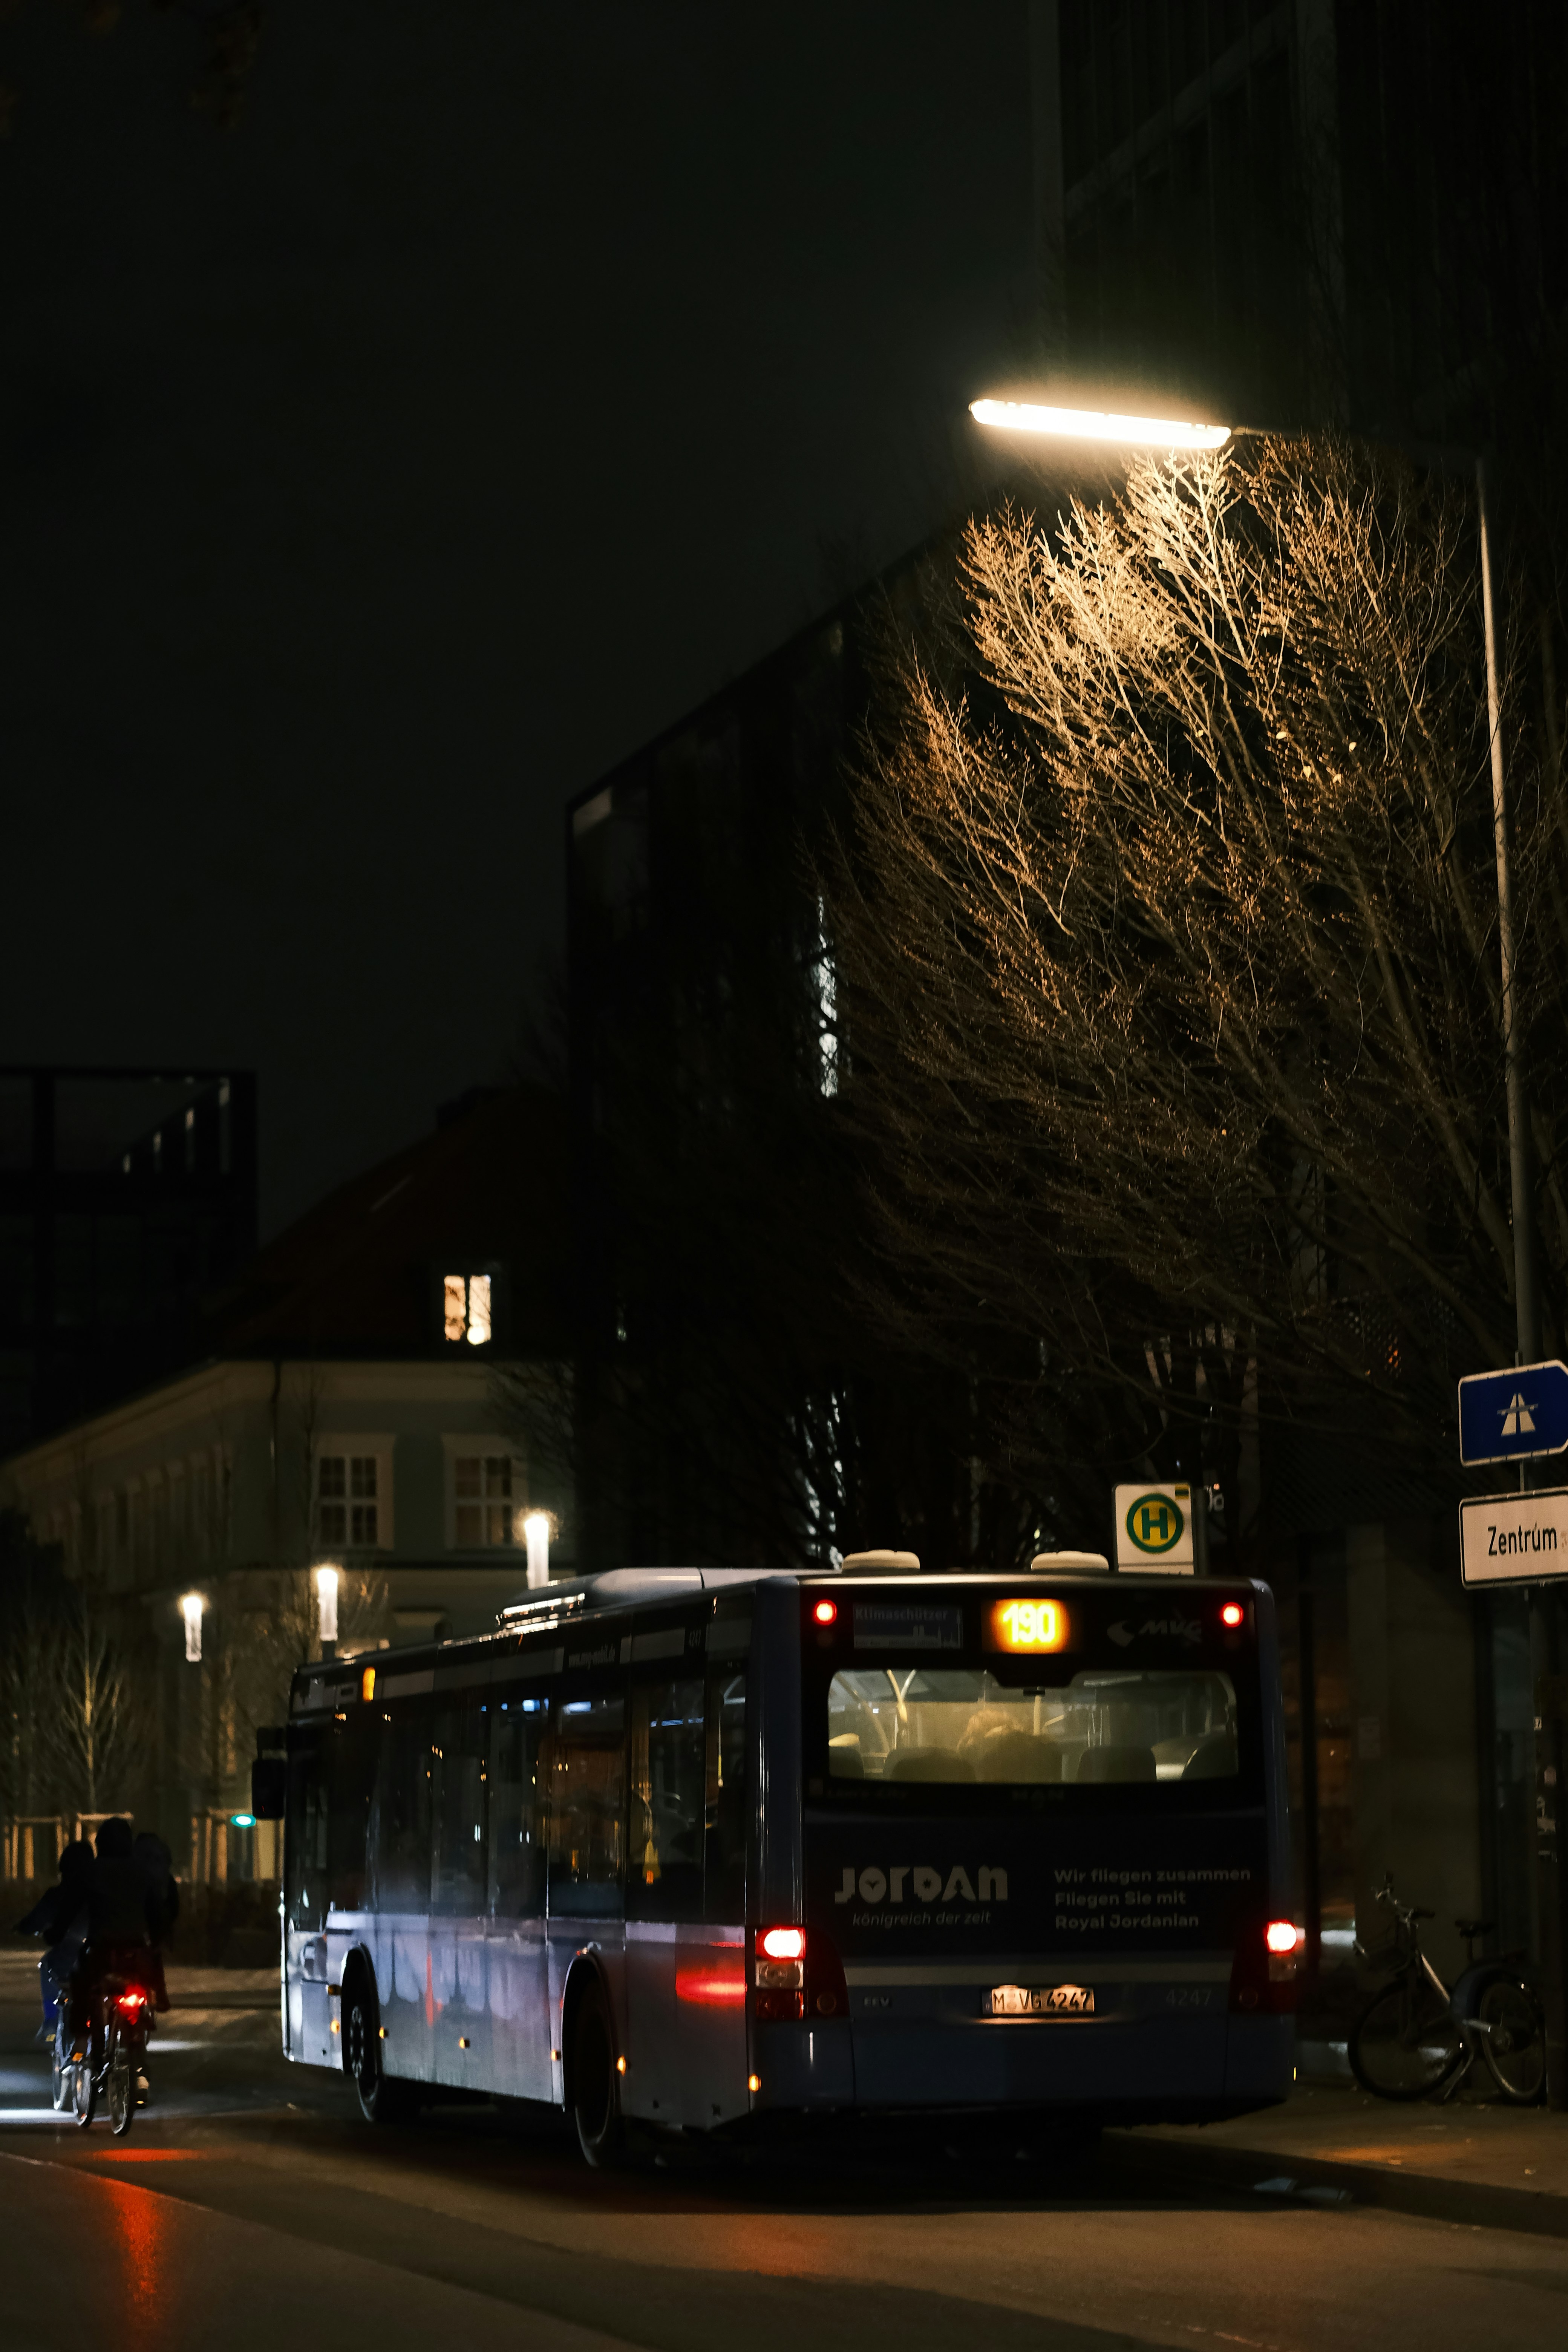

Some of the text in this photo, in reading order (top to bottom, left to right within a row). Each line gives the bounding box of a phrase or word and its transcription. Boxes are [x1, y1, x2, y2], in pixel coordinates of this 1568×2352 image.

[1142, 1508, 1168, 1539] H
[855, 1607, 948, 1621] Klimaschützer
[1003, 1603, 1056, 1643] 190
[1055, 1868, 1251, 1885] Wir fliegen zusammen
[1055, 1890, 1187, 1909] Fliegen Sie mit
[936, 1912, 961, 1925] der
[964, 1910, 992, 1924] zeit
[1055, 1913, 1199, 1932] Royal Jordanian
[994, 1993, 1004, 2010] M
[1047, 1991, 1090, 2010] 4247
[1165, 1988, 1213, 2007] 4247
